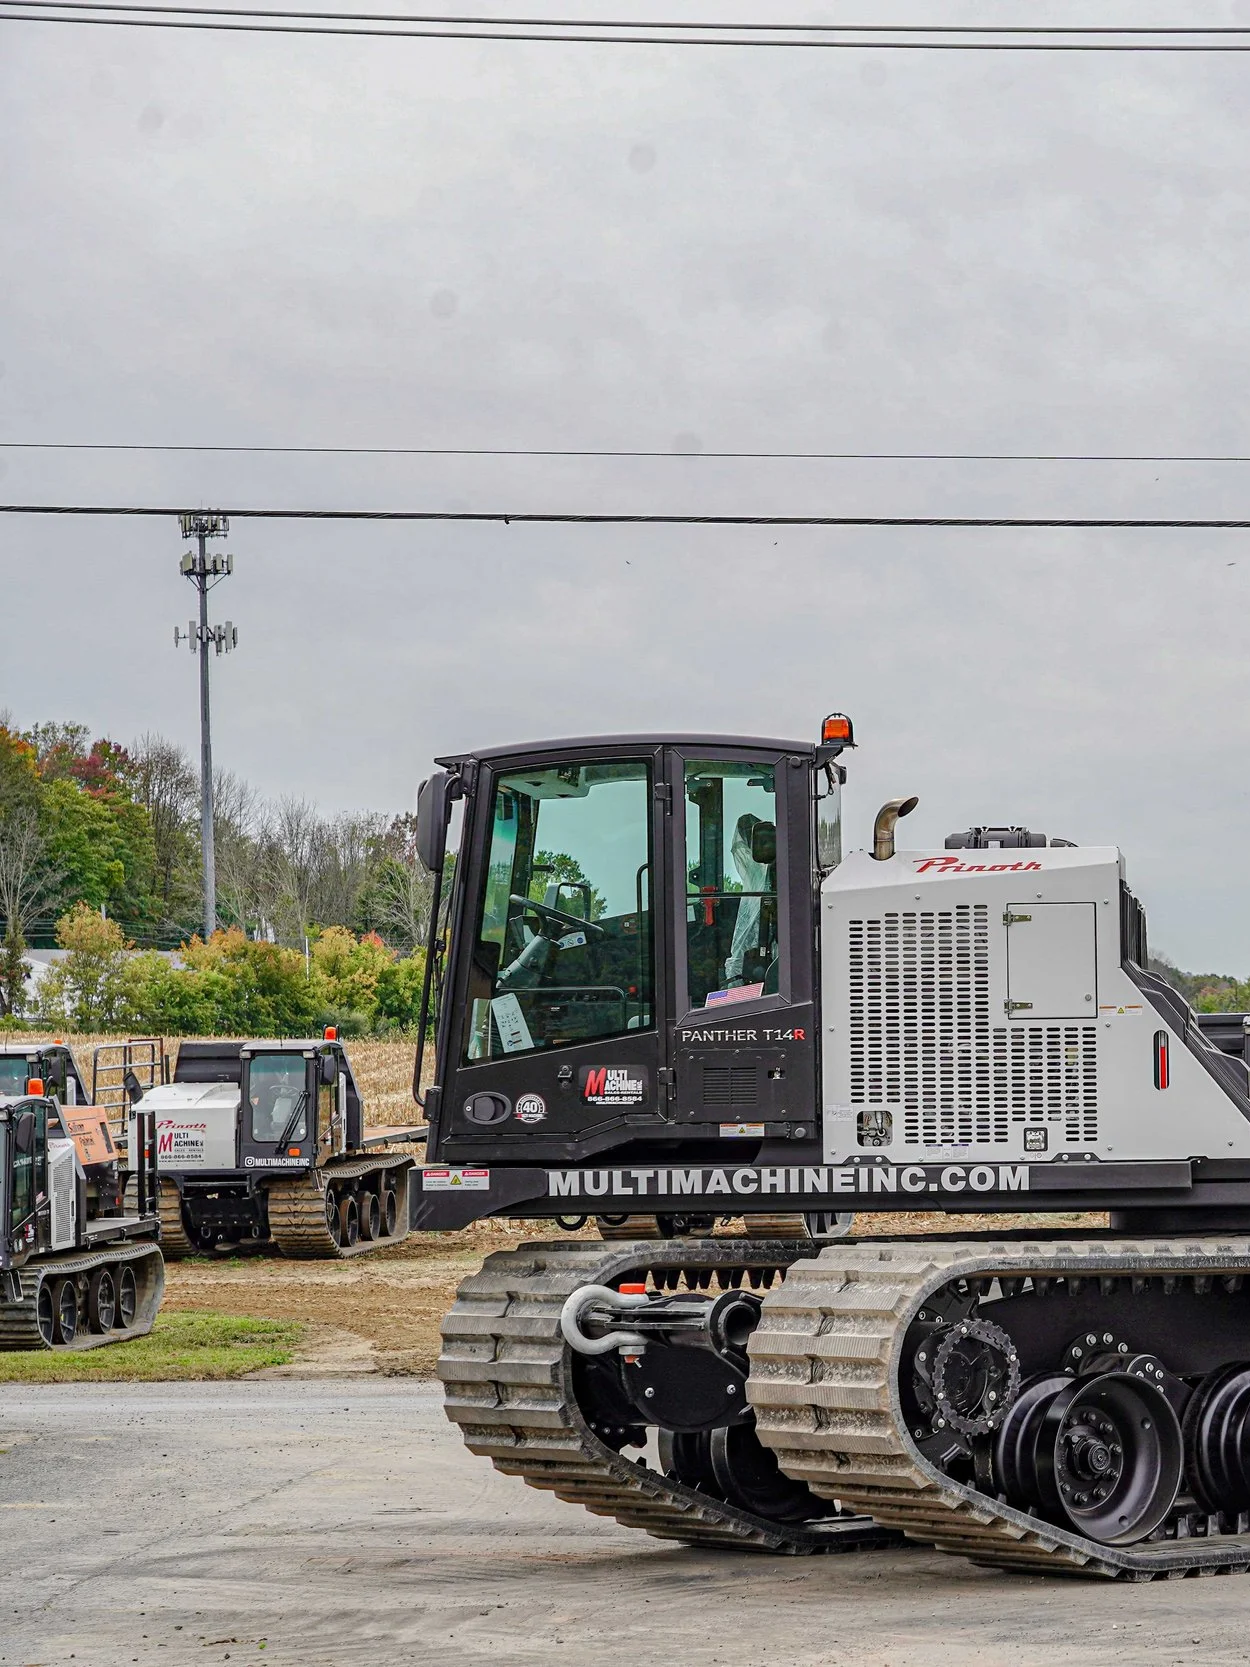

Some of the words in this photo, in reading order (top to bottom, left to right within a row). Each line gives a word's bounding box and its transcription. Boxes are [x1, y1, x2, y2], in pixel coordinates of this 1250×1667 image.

[913, 856, 1042, 873] Prinoth
[682, 1030, 757, 1042] PANTHER
[763, 1028, 805, 1041] T14R
[523, 1101, 538, 1113] 40
[156, 1119, 207, 1129] Prinoth
[255, 1157, 310, 1167] MULTIMACHINEINC
[548, 1166, 1030, 1197] MULTIMACHINEINC.COM
